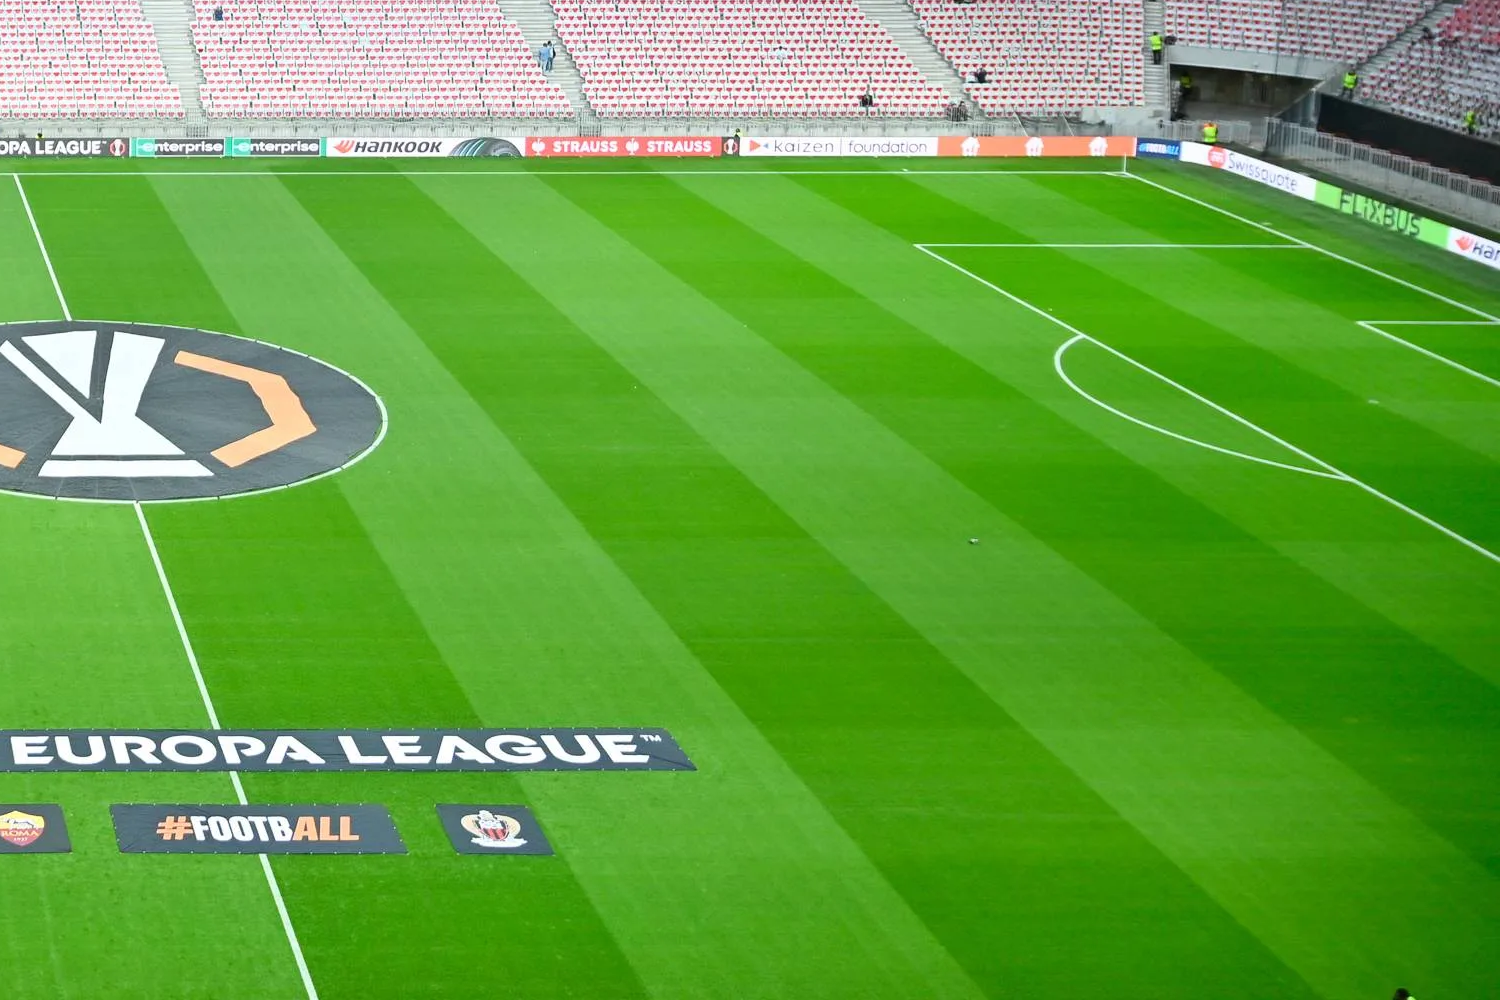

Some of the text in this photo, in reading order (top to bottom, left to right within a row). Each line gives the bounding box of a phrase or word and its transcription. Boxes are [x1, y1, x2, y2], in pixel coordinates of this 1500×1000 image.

[142, 140, 223, 154] enterprise
[237, 140, 319, 154] enterprise
[553, 140, 618, 153] STRAUSS
[647, 140, 711, 153] STRAUSS
[774, 139, 927, 153] kaizen foundation
[1229, 154, 1298, 191] Swissquote
[12, 736, 325, 765] EUROPA
[156, 815, 361, 842] #FOOTBALL
